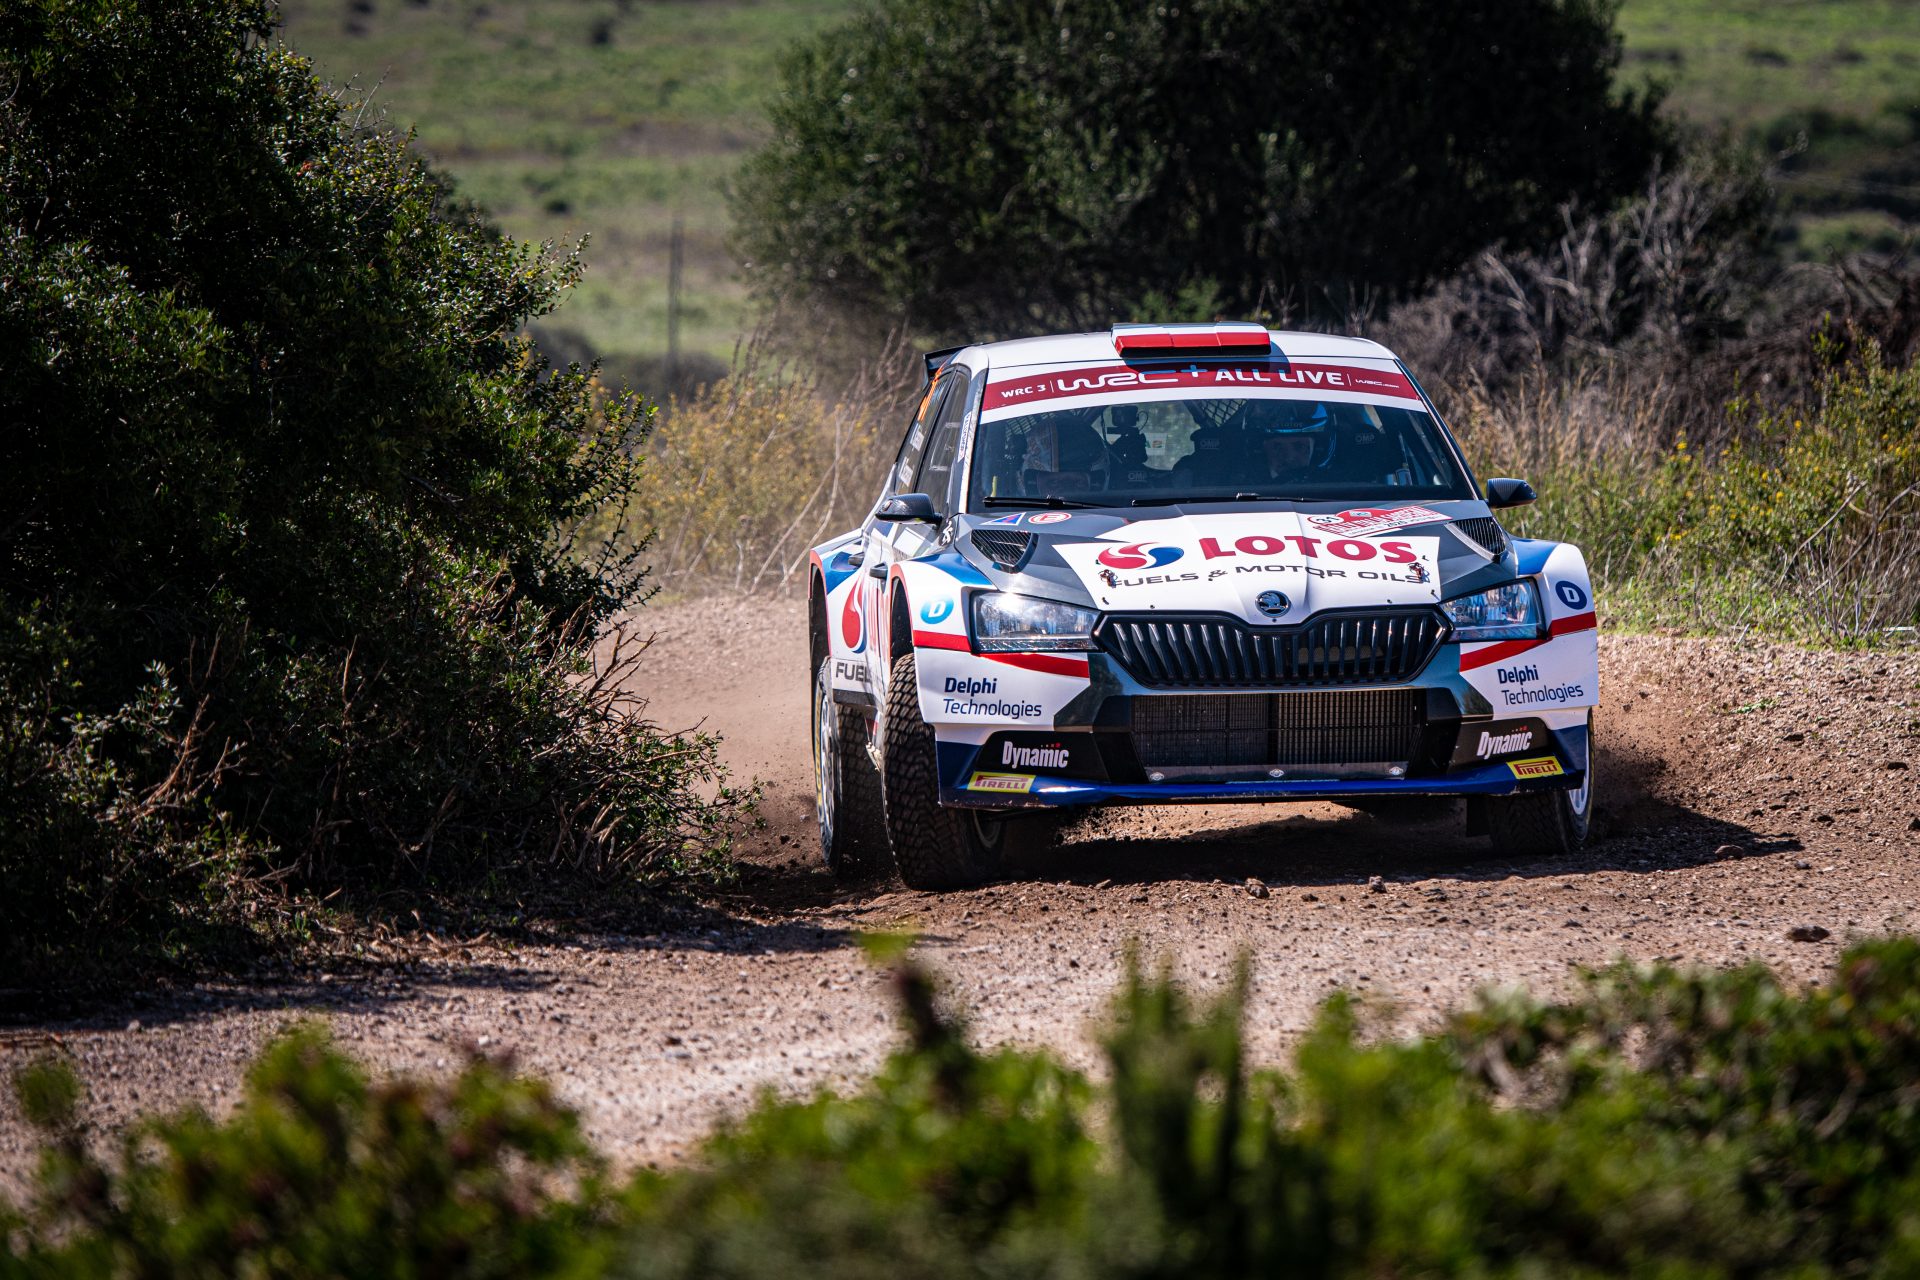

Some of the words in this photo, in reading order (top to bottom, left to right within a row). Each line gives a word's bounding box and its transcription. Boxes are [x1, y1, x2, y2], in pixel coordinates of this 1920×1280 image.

[1001, 386, 1034, 398] WRC
[1037, 384, 1046, 392] 3
[1215, 368, 1271, 382] ALL
[1278, 369, 1345, 386] LIVE
[1199, 535, 1418, 564] LOTOS
[1235, 565, 1347, 579] MOTOR
[1497, 664, 1539, 686] Delphi
[944, 677, 998, 697] Delphi
[1501, 683, 1584, 706] Technologies
[943, 698, 1042, 719] Technologies
[1002, 740, 1069, 769] Dynamic
[1476, 731, 1533, 760] Dynamic
[1513, 760, 1558, 776] PIRELLI
[974, 774, 1029, 790] PIRELLI
